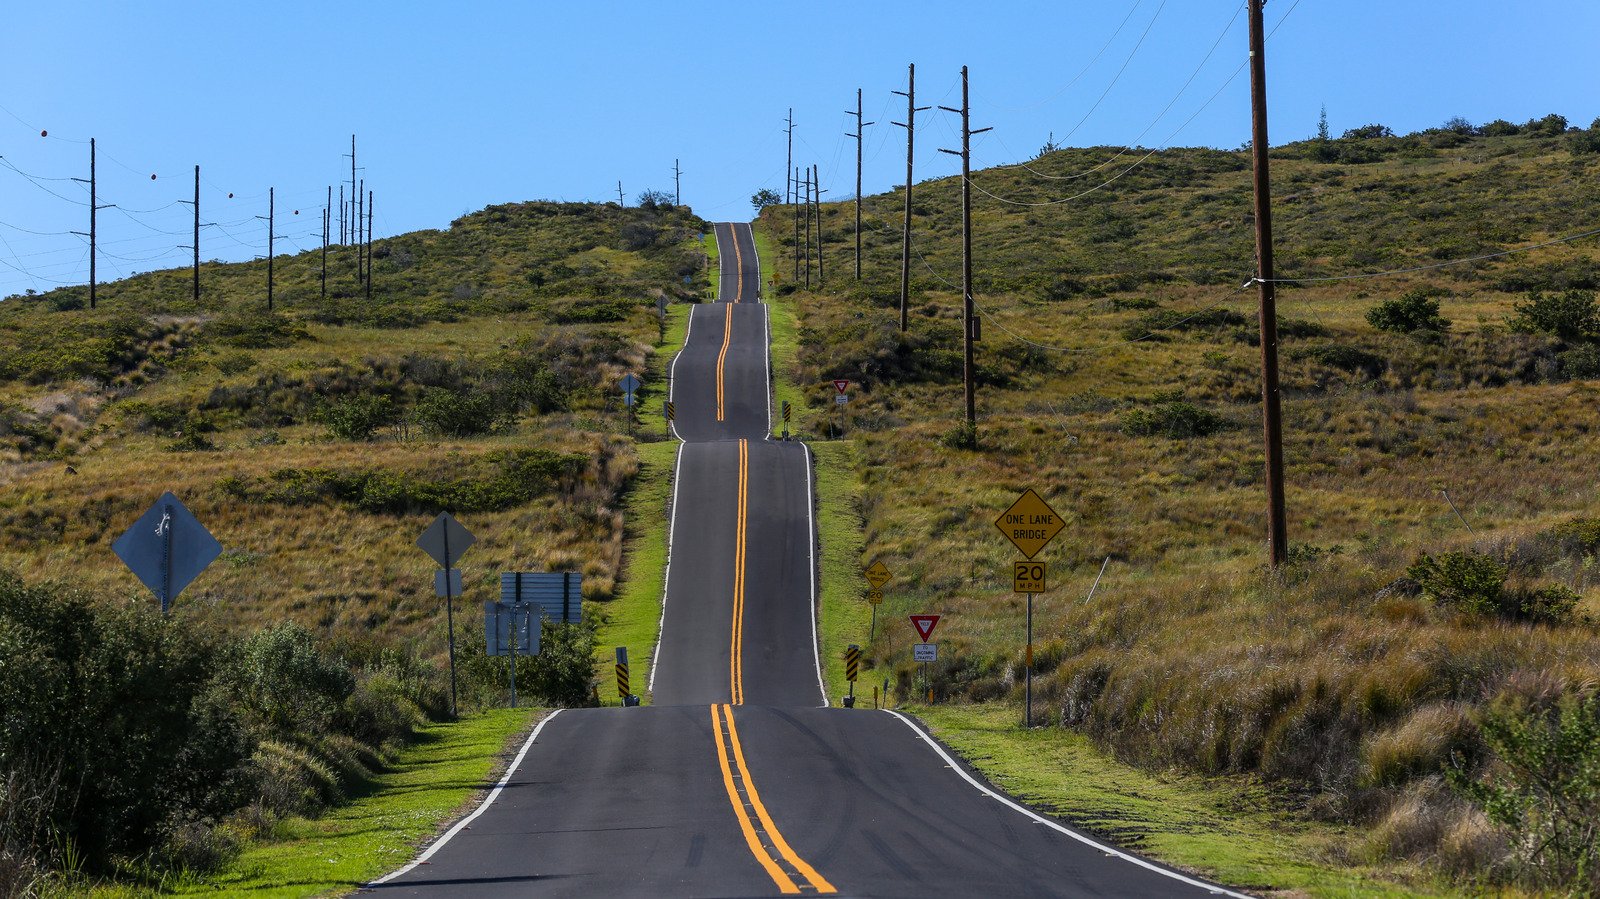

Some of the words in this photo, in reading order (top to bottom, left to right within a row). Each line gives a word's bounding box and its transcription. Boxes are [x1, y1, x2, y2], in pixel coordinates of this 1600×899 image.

[1006, 514, 1025, 525] ONE
[1029, 514, 1054, 525] LANE
[1013, 529, 1047, 540] BRIDGE
[1016, 565, 1043, 581] 20
[1019, 582, 1040, 590] MPH
[870, 591, 882, 599] 20
